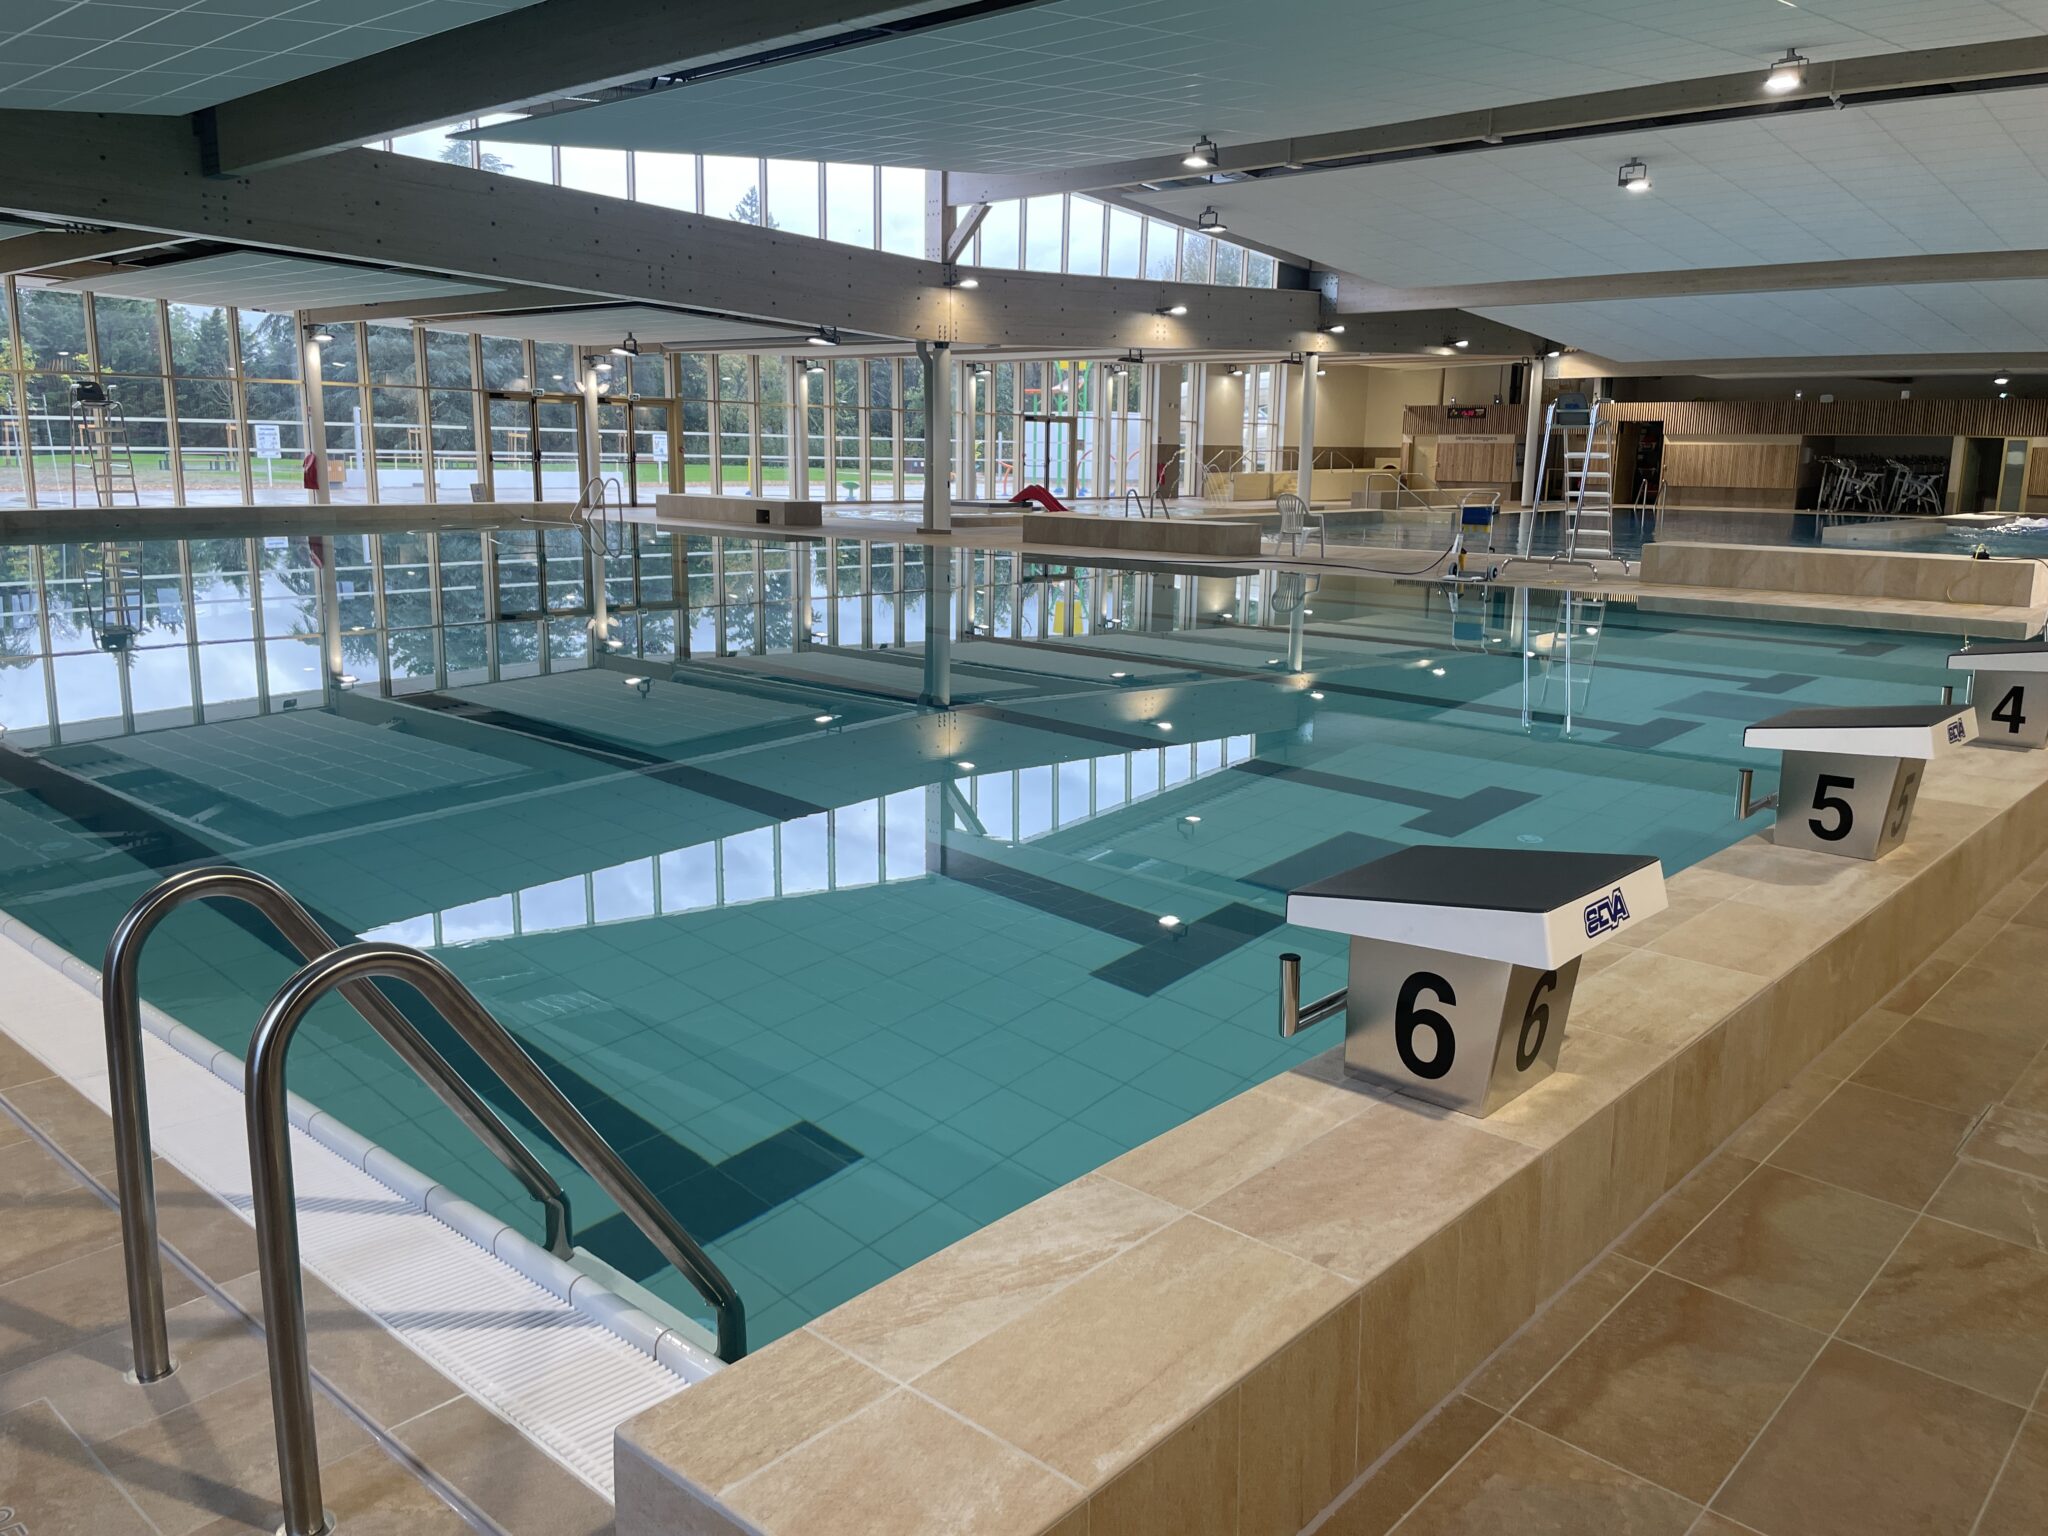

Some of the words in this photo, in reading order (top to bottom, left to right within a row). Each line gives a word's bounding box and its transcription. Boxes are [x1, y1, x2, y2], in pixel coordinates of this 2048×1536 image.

[1991, 686, 2026, 734] 4
[1808, 774, 1855, 841] 5
[1890, 772, 1916, 838] 5
[1395, 971, 1457, 1080] 6
[1516, 970, 1557, 1072] 6
